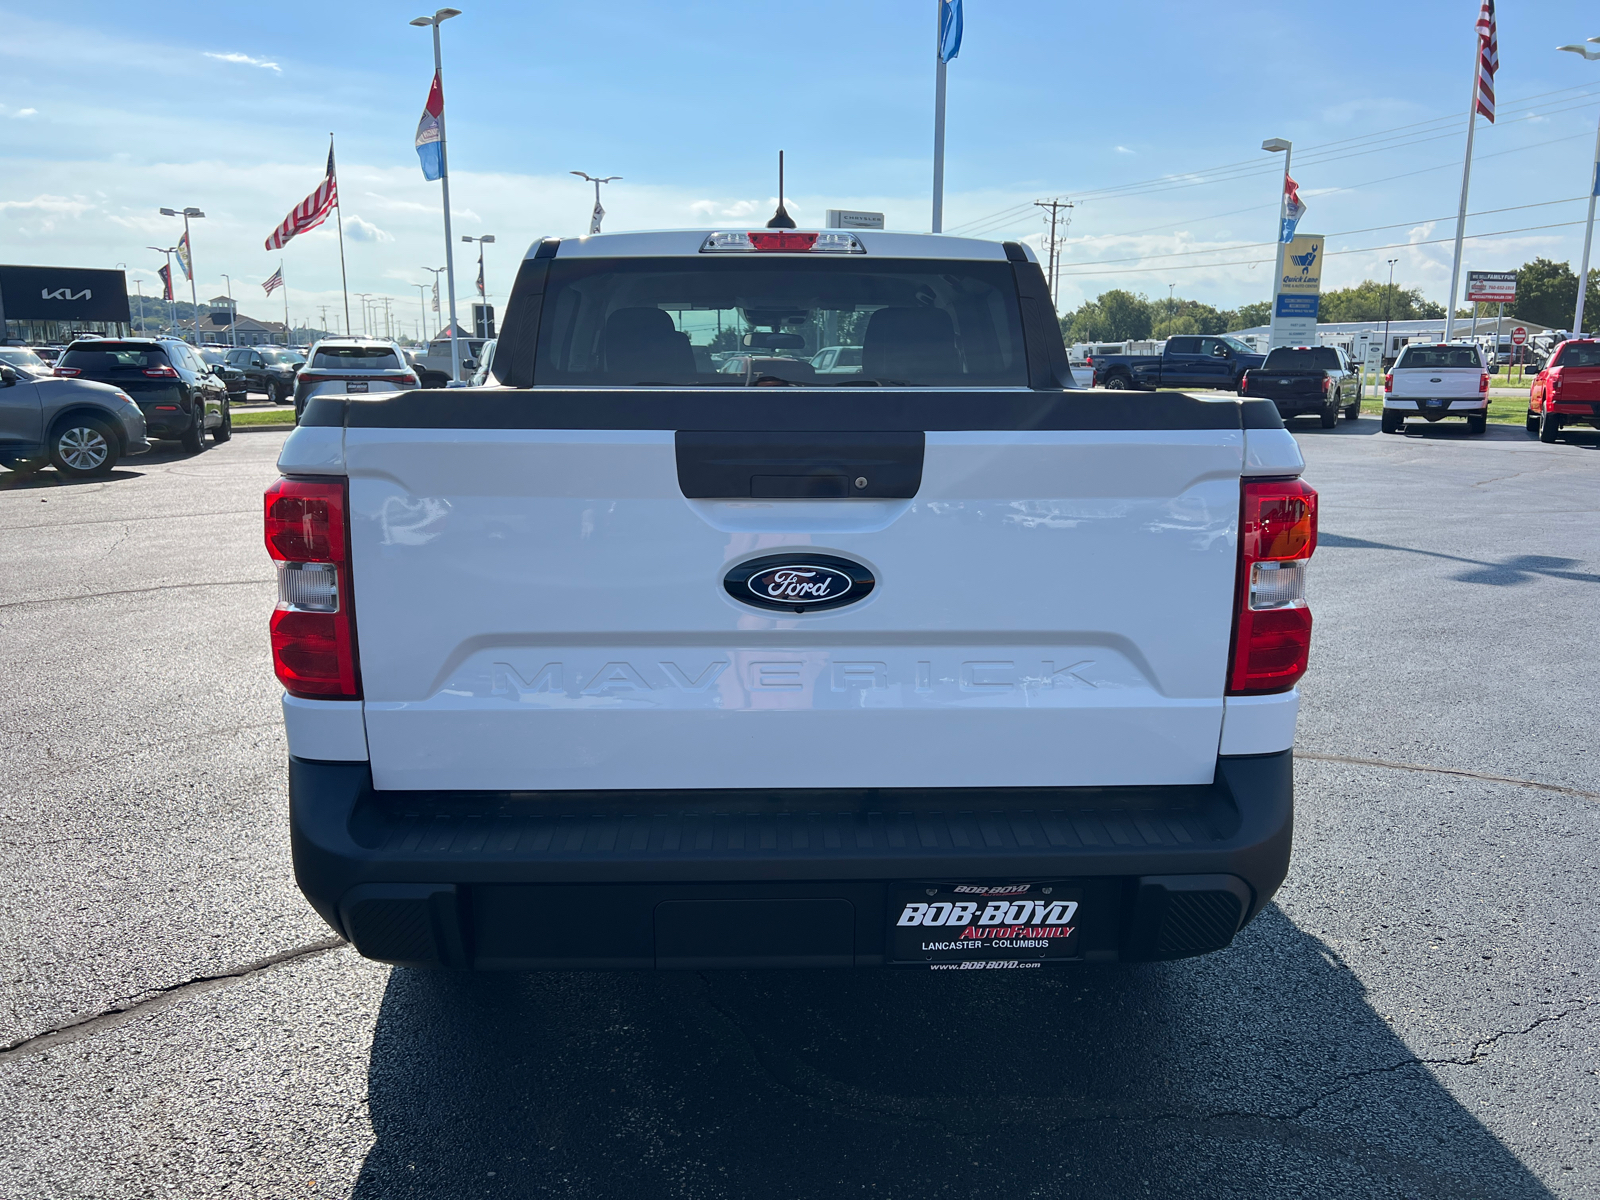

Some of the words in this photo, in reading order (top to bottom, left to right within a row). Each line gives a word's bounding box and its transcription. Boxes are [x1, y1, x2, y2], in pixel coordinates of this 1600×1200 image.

[41, 287, 92, 300] KIA
[767, 569, 832, 597] Ford
[490, 660, 1098, 695] MAVERICK
[922, 940, 982, 951] LANCASTER
[992, 939, 1049, 949] COLUMBUS
